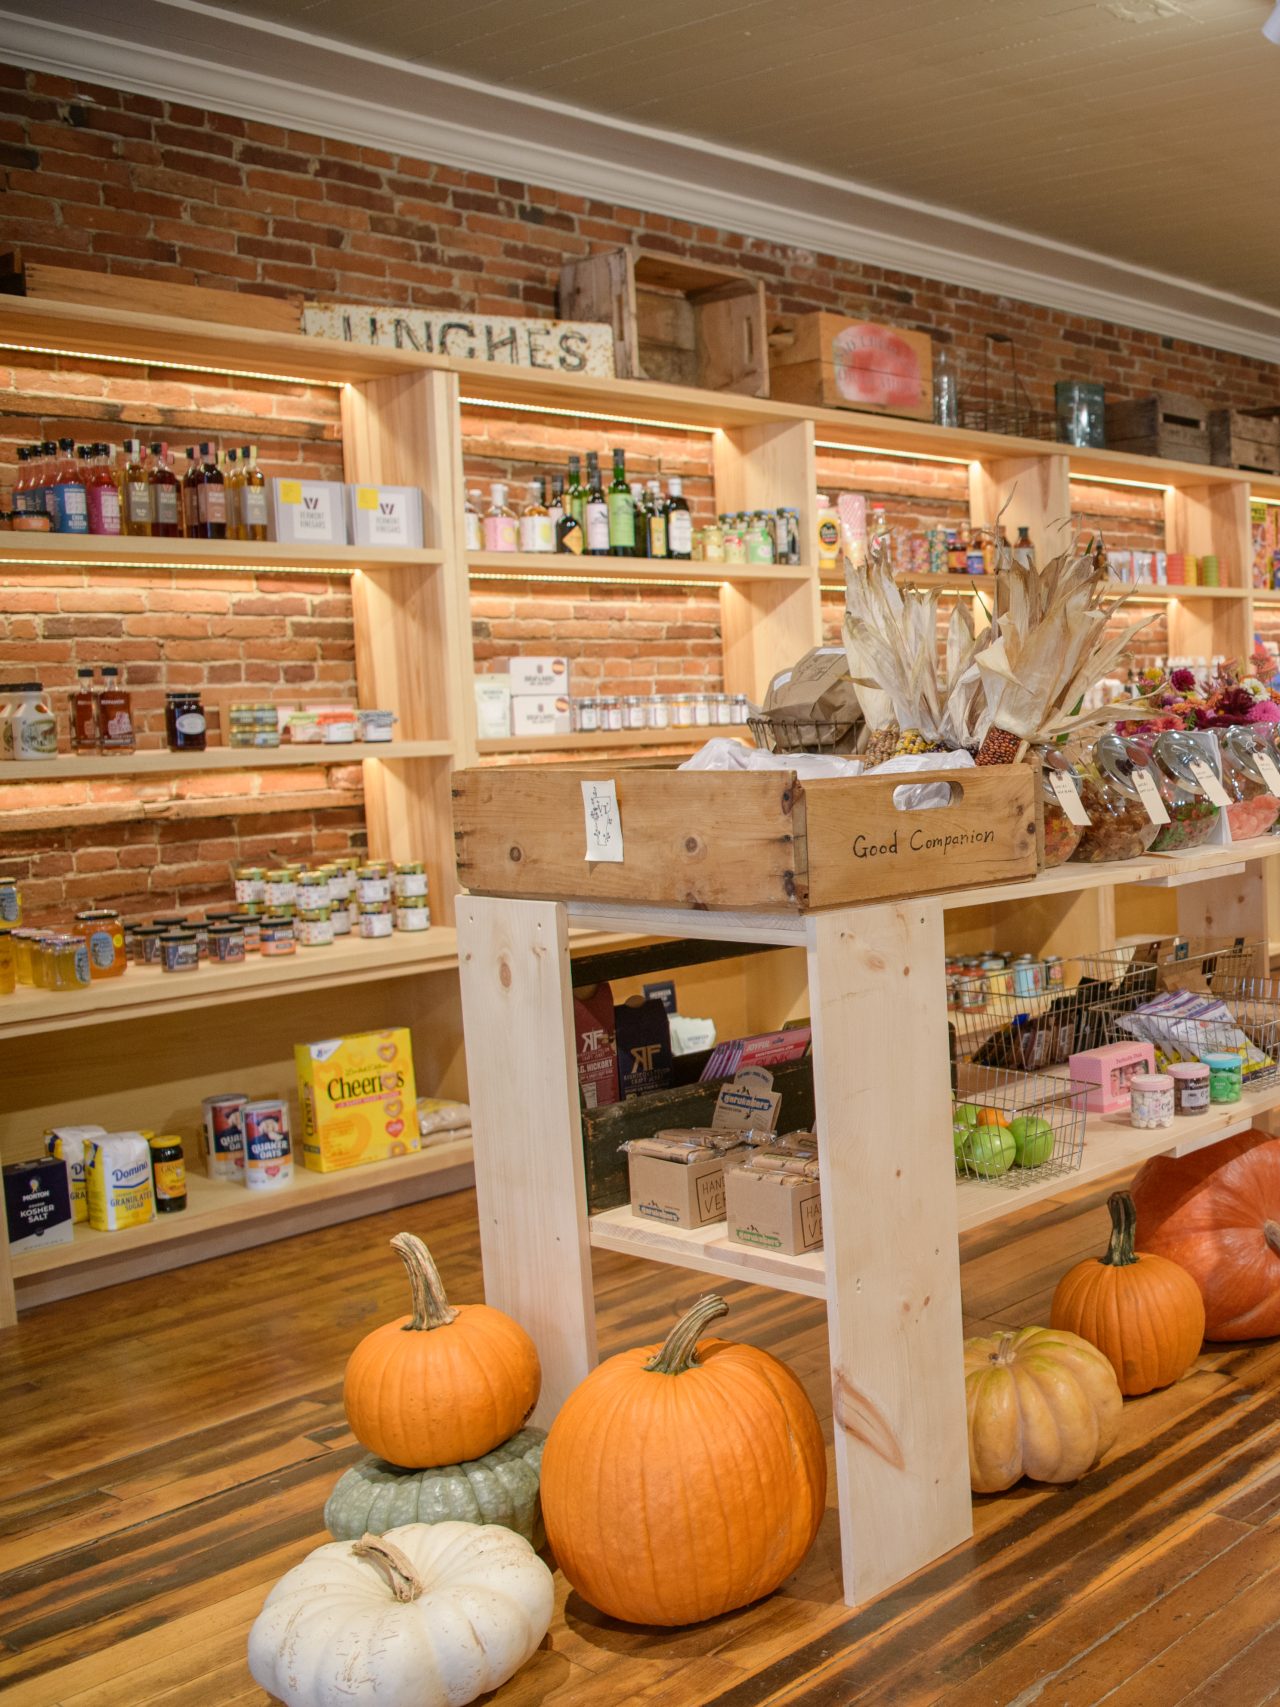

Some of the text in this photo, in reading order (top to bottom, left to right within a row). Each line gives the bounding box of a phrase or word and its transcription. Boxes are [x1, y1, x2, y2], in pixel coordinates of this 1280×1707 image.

[302, 312, 588, 372] UNCHES
[852, 829, 994, 858] Good Companion
[586, 1059, 613, 1072] HICKORY
[251, 1140, 288, 1154] QUAKER
[260, 1149, 282, 1160] OATS
[112, 1162, 148, 1182] Domino
[22, 1190, 50, 1202] MORTON
[20, 1204, 54, 1218] KOSHER
[125, 1202, 144, 1212] SUGAR
[28, 1213, 48, 1224] SALT
